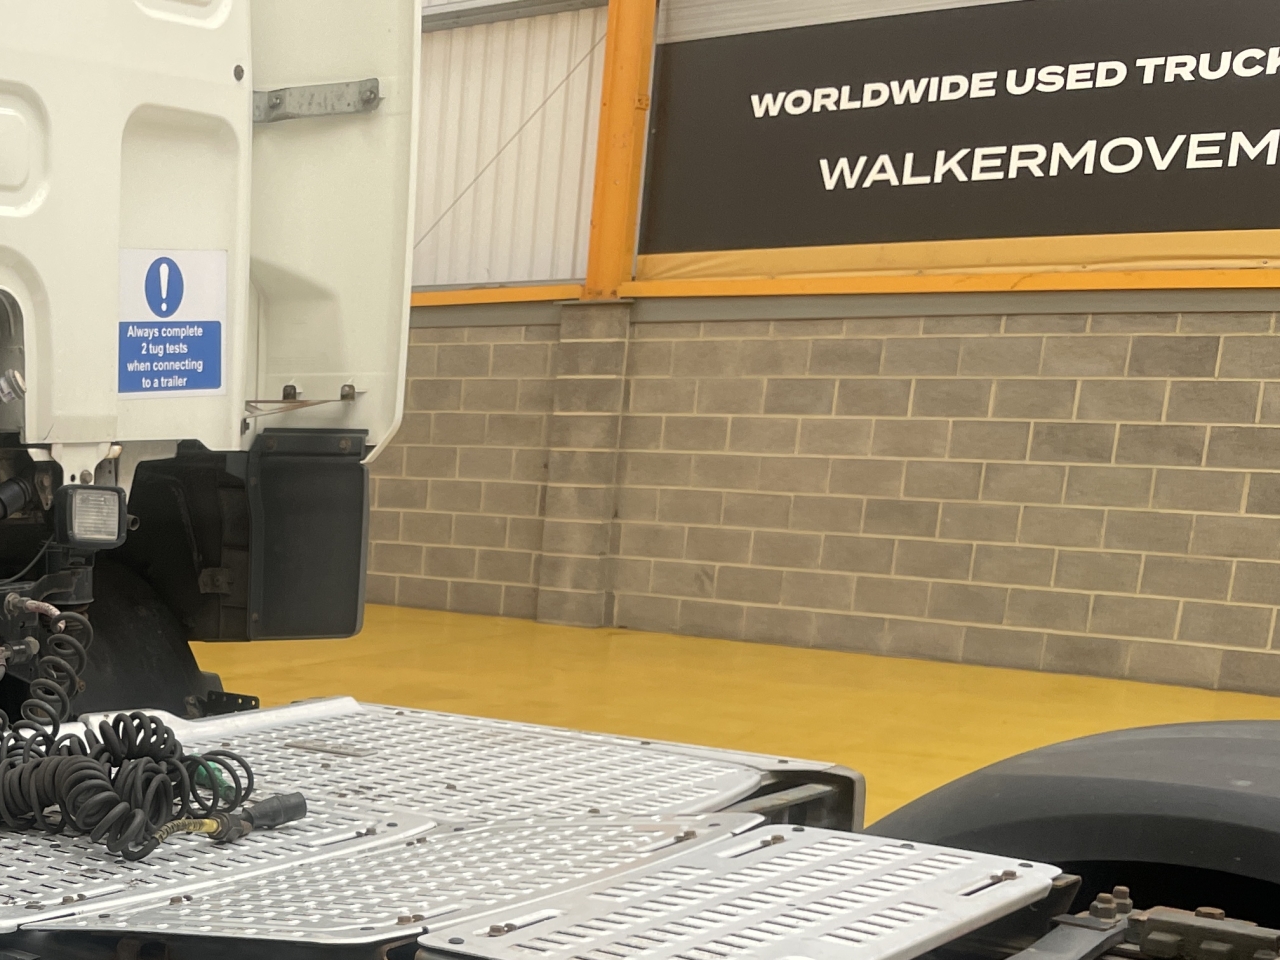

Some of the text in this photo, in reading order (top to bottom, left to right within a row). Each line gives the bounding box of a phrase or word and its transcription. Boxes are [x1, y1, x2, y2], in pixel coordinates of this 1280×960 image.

[751, 71, 998, 118] WORLDWIDE
[1006, 60, 1128, 95] USED
[819, 129, 1280, 190] WALKERMOVEM
[127, 325, 203, 340] Always complete
[141, 342, 188, 357] 2 tug tests
[127, 358, 203, 373] when connecting
[142, 375, 187, 388] to a trailer
